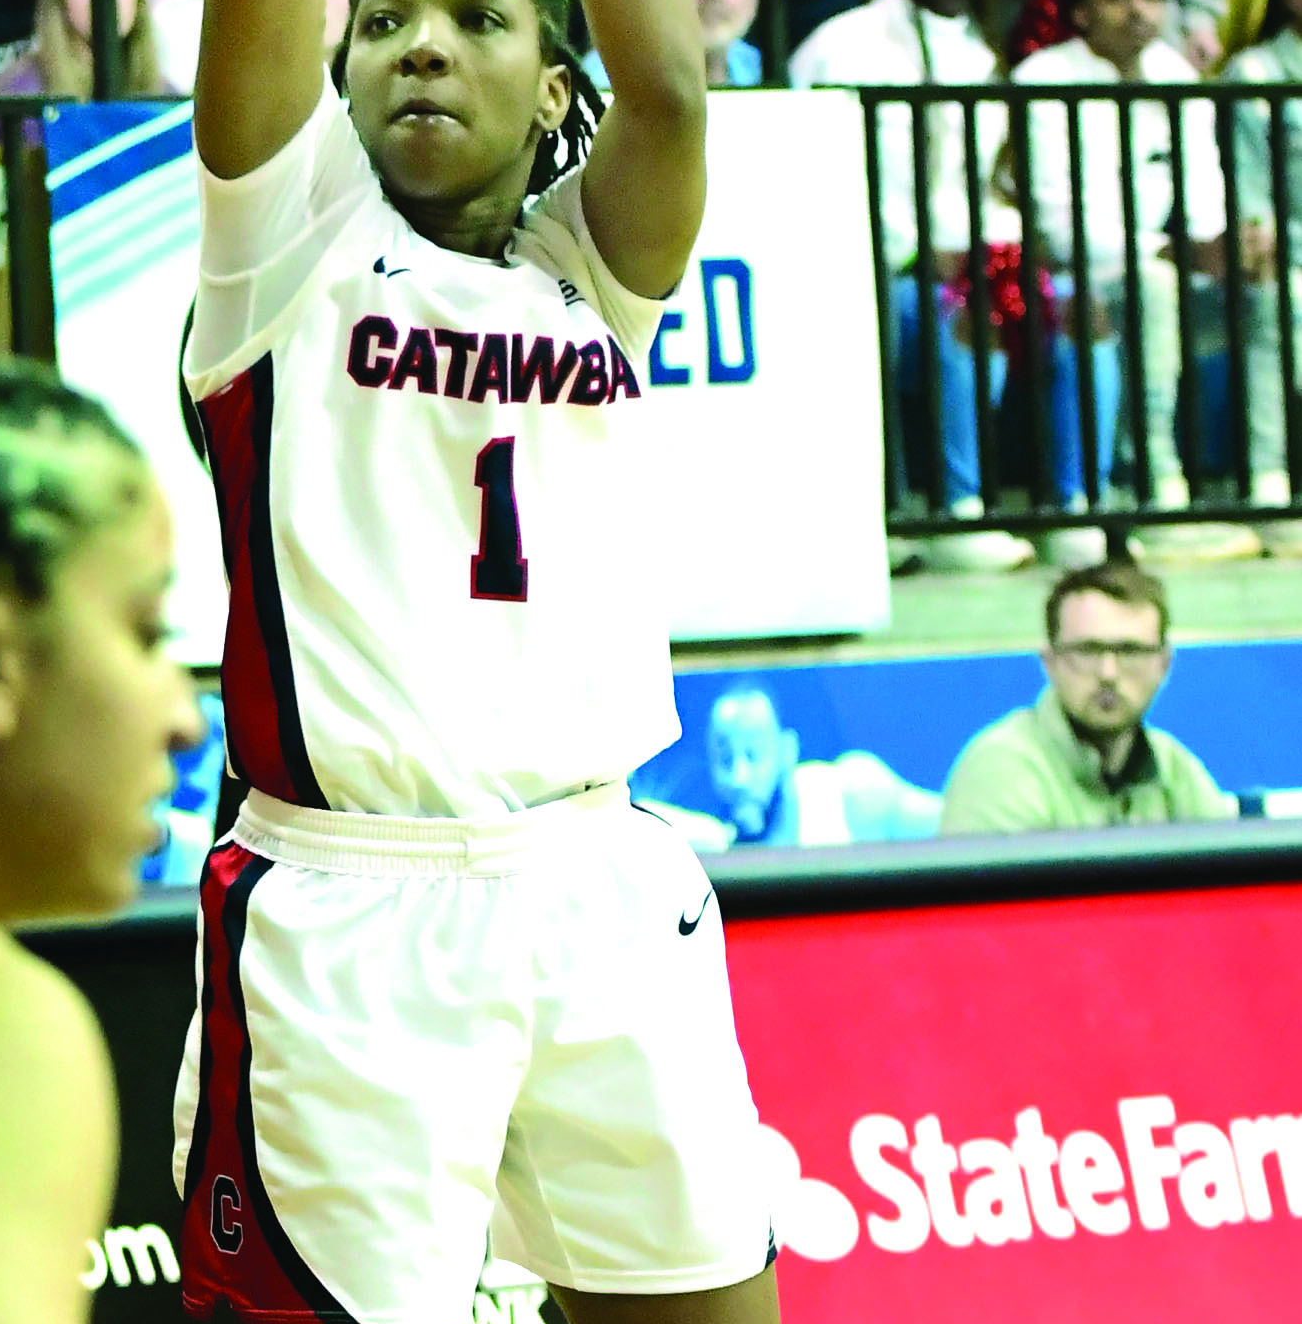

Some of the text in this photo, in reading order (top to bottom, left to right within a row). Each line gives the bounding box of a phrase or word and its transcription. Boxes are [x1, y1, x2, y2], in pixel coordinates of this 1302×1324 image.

[347, 315, 641, 406] CATAWBA
[470, 436, 528, 602] 1
[211, 1174, 243, 1255] C
[850, 1094, 1302, 1253] StateFar
